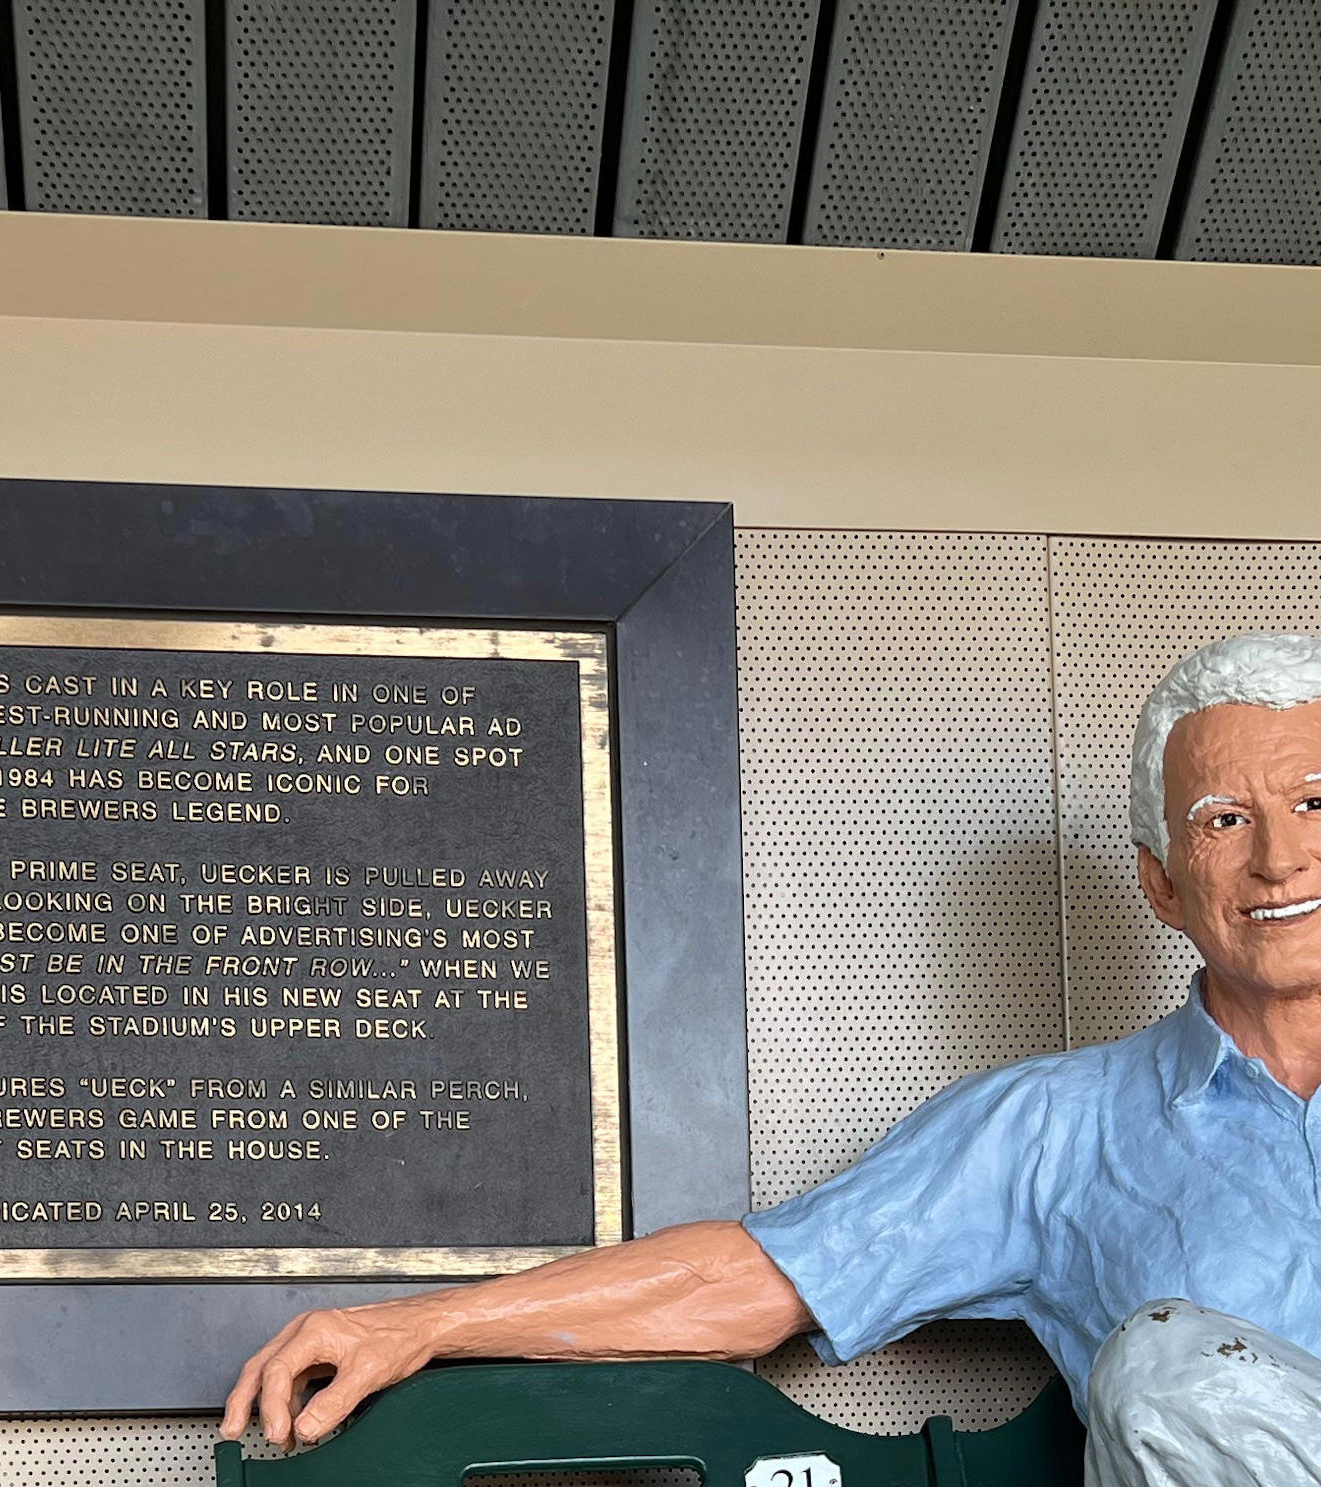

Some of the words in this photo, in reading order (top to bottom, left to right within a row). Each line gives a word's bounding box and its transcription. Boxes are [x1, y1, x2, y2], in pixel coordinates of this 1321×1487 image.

[25, 674, 97, 695] CAST
[111, 676, 137, 696] IN
[151, 678, 168, 697] A
[181, 678, 232, 699] KEY
[247, 680, 318, 702] ROLE
[333, 683, 357, 702] IN
[372, 683, 427, 704] ONE
[441, 685, 475, 705] OF
[192, 709, 247, 730] AND
[262, 711, 337, 732] MOST
[351, 713, 475, 736] POPULAR
[487, 716, 521, 737] AD
[76, 737, 137, 758] LITE
[147, 739, 195, 760] ALL
[210, 740, 303, 764] STARS,
[316, 743, 371, 764] AND
[384, 744, 440, 765] ONE
[454, 746, 523, 767] SPOT
[69, 768, 123, 788] HAS
[138, 770, 253, 792] BECOME
[267, 773, 361, 794] ICONIC
[375, 772, 428, 795] FOR
[21, 798, 157, 820] BREWERS
[172, 801, 289, 823] LEGEND.
[10, 859, 97, 880] PRIME
[112, 861, 185, 884] SEAT,
[201, 863, 311, 884] UECKER
[326, 866, 350, 885] IS
[365, 866, 465, 887] PULLED
[479, 868, 548, 888] AWAY
[127, 893, 165, 913] ON
[179, 893, 232, 914] THE
[247, 894, 346, 915] BRIGHT
[362, 896, 431, 919] SIDE,
[446, 898, 552, 919] UECKER
[120, 923, 177, 943] ONE
[192, 924, 228, 945] OF
[240, 925, 447, 948] ADVERTISING'S
[462, 928, 535, 949] MOST
[47, 953, 83, 973] BE
[97, 954, 124, 974] IN
[139, 954, 192, 974] THE
[205, 955, 298, 976] FRONT
[419, 958, 497, 979] WHEN
[510, 959, 550, 979] WE
[1, 983, 26, 1004] IS
[41, 984, 167, 1005] LOCATED
[183, 986, 208, 1005] IN
[224, 986, 268, 1007] HIS
[282, 987, 342, 1007] NEW
[355, 988, 422, 1008] SEAT
[434, 989, 464, 1009] AT
[476, 989, 528, 1010] THE
[19, 1015, 74, 1035] THE
[89, 1016, 236, 1037] STADIUM'S
[250, 1017, 341, 1038] UPPER
[355, 1018, 435, 1039] DECK.
[190, 1078, 266, 1098] FROM
[279, 1079, 296, 1098] A
[309, 1079, 417, 1100] SIMILAR
[431, 1080, 527, 1102] PERCH,
[118, 1108, 197, 1129] GAME
[211, 1109, 288, 1129] FROM
[302, 1109, 357, 1130] ONE
[371, 1110, 406, 1130] OF
[419, 1110, 470, 1129] THE
[17, 1139, 105, 1159] SEATS
[120, 1139, 146, 1159] IN
[160, 1139, 213, 1159] THE
[228, 1139, 329, 1160] HOUSE.
[116, 1201, 196, 1221] APRIL
[208, 1201, 247, 1223] 25,
[261, 1201, 321, 1221] 2014
